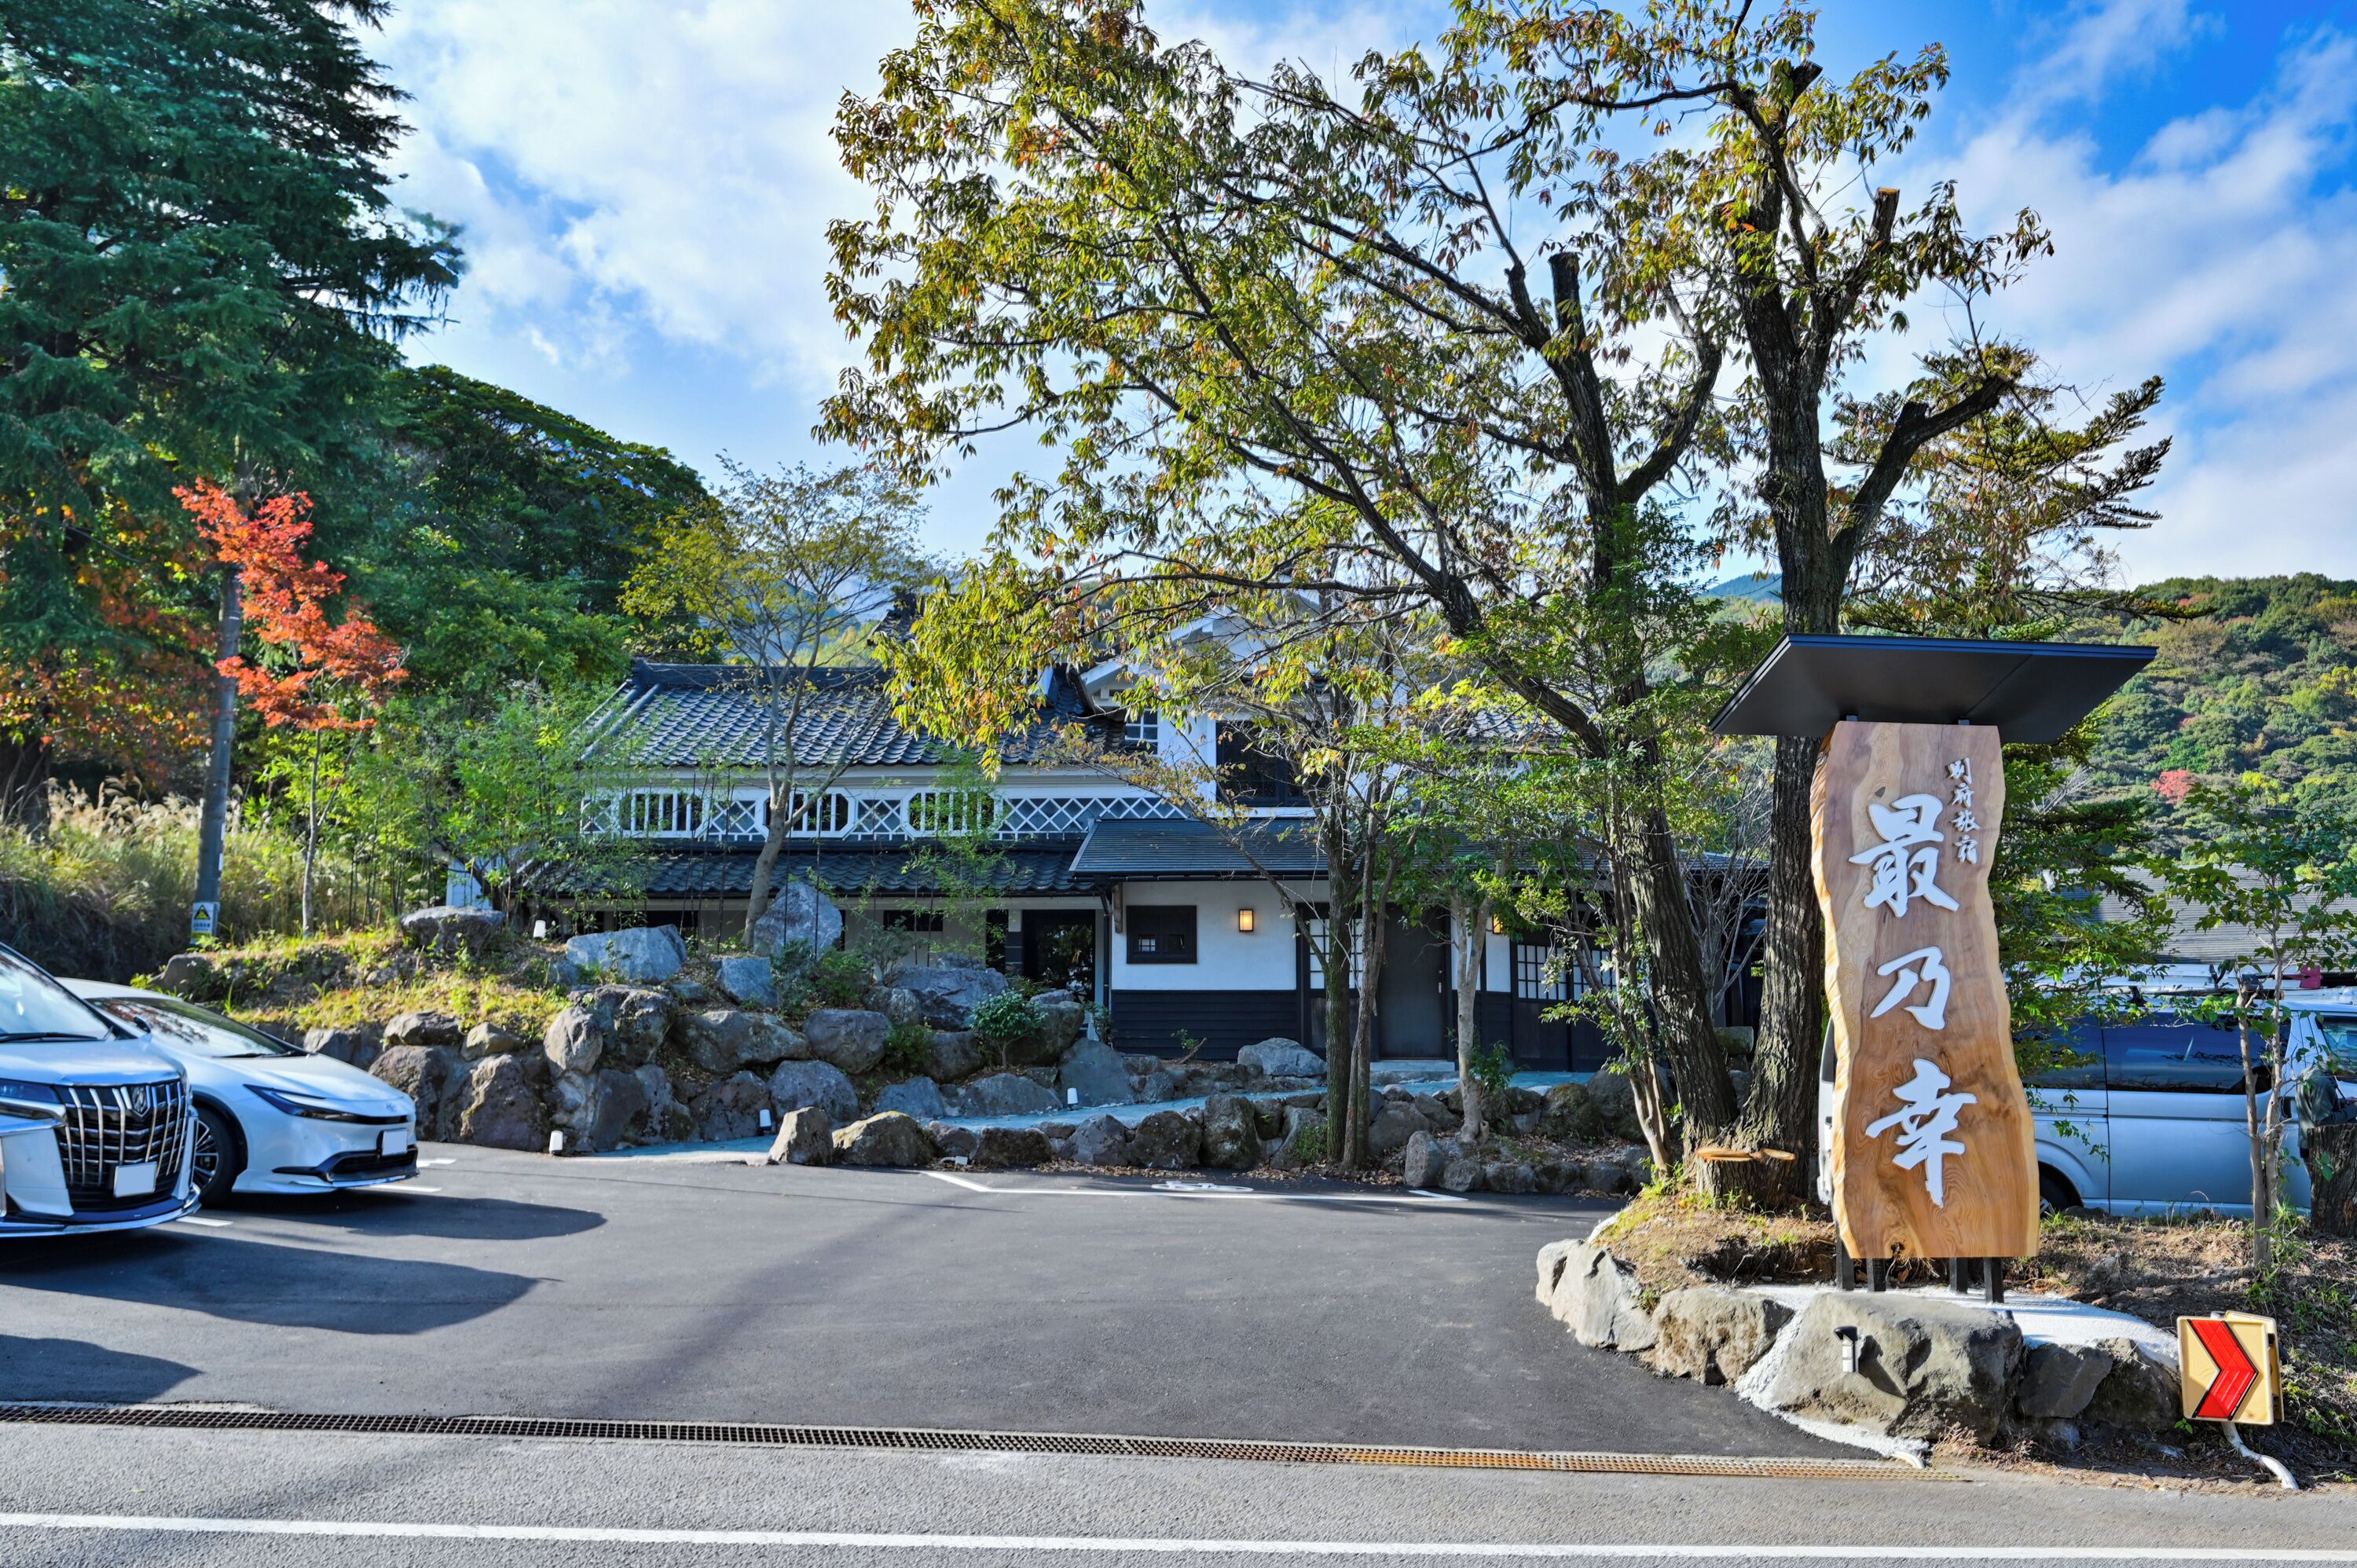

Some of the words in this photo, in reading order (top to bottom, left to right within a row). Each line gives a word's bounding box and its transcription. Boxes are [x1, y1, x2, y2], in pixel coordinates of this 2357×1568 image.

[1948, 757, 1981, 865] 別府旅宿
[1848, 793, 1978, 1208] 最乃幸
